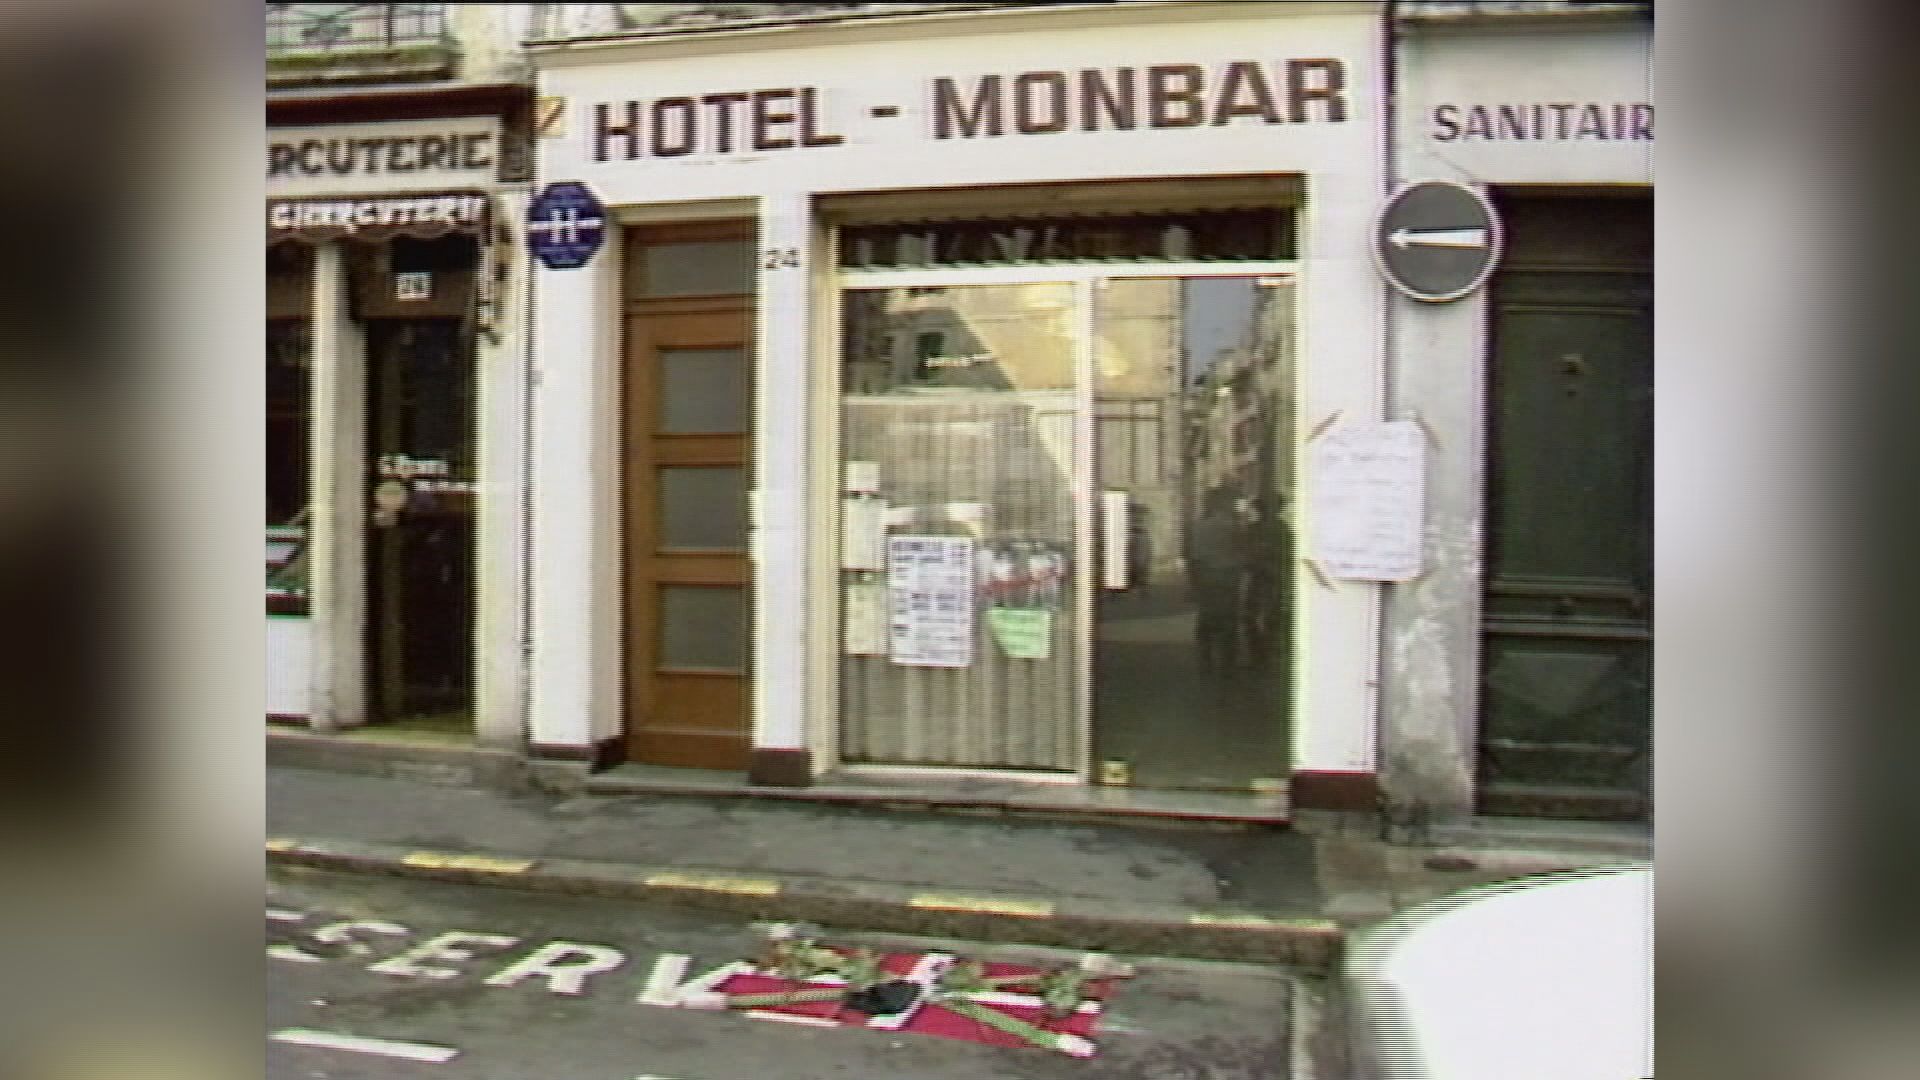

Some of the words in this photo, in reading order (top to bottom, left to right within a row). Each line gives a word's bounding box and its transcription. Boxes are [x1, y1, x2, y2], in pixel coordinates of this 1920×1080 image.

[594, 87, 844, 161] HOTEL
[934, 57, 1348, 140] MONBAR
[1433, 103, 1653, 142] SANITAIR
[764, 248, 800, 270] 24
